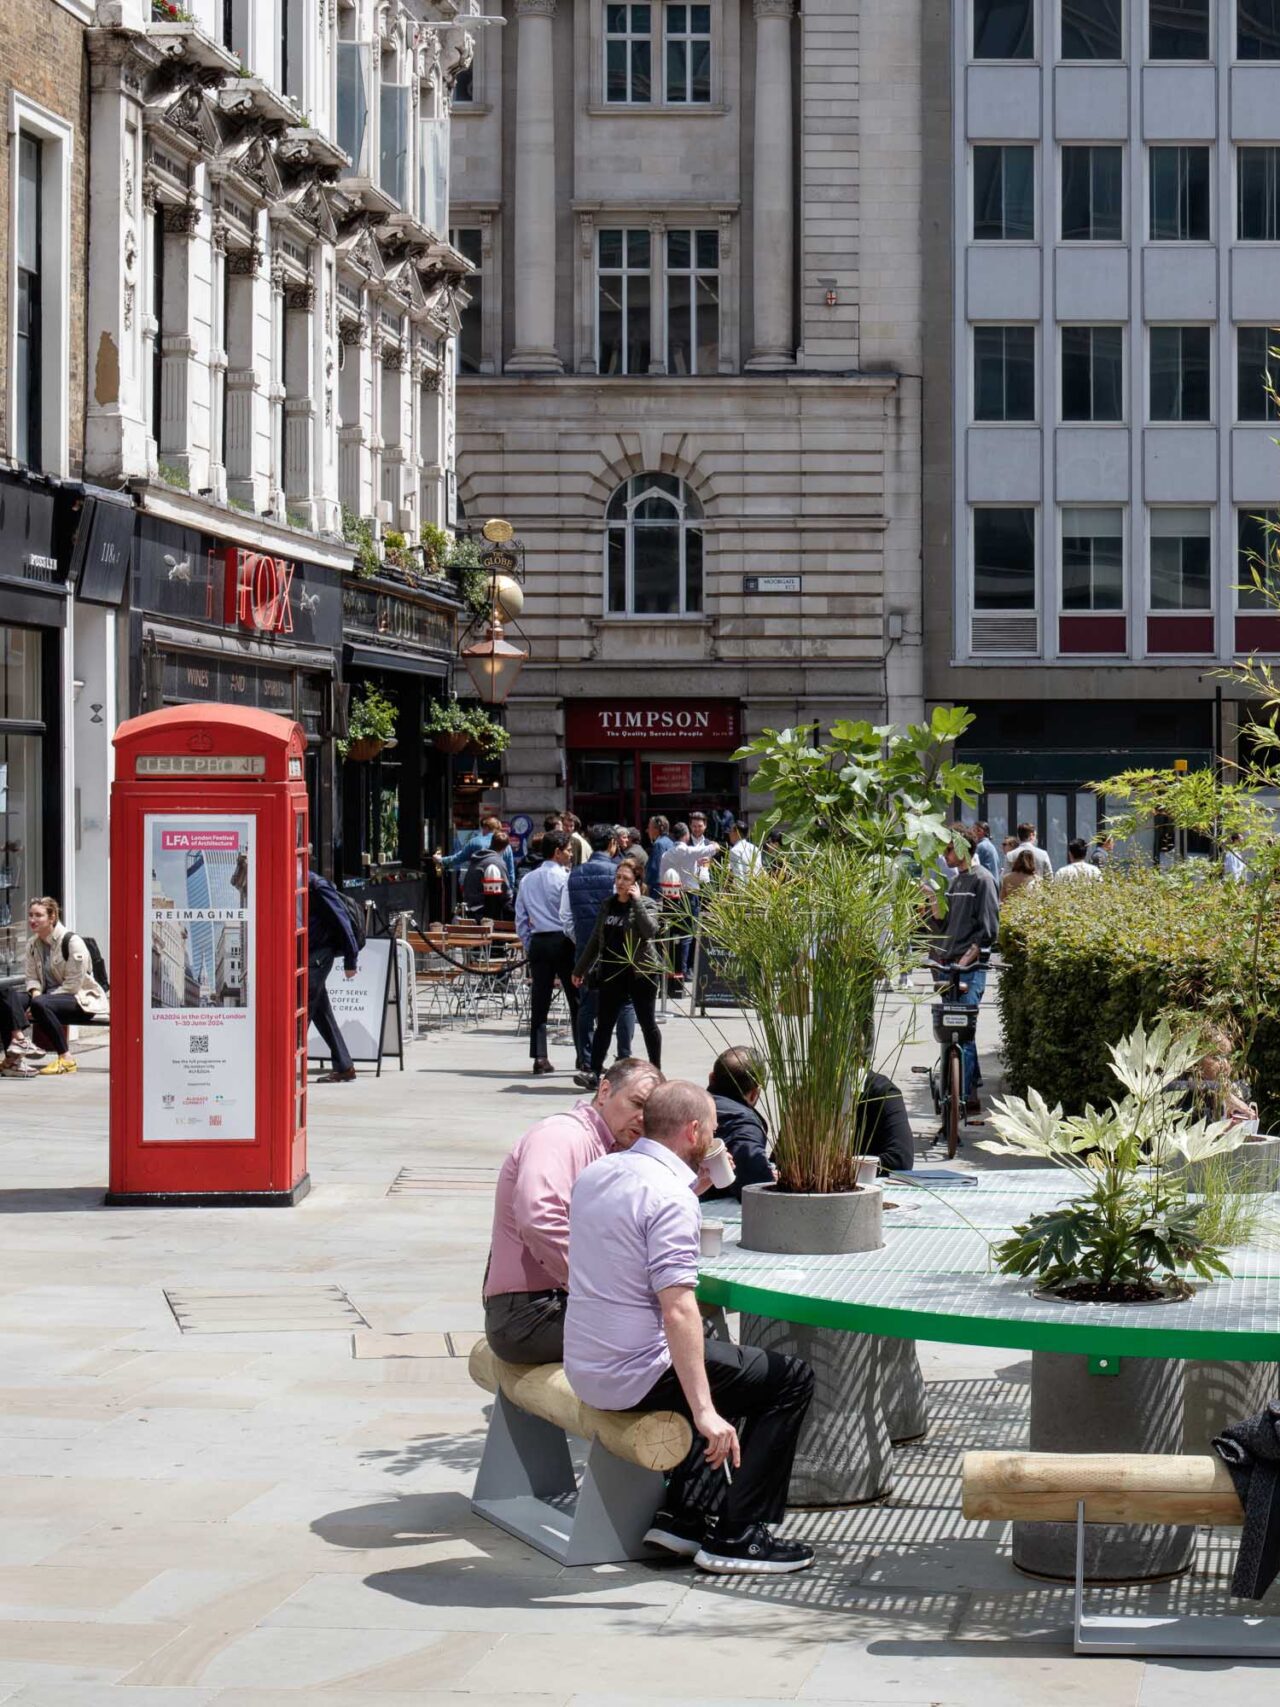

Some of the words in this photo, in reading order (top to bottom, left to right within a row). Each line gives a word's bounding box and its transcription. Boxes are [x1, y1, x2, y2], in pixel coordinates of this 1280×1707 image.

[483, 556, 513, 568] GLOBE
[224, 546, 295, 635] FOX
[187, 667, 209, 688] WINES
[231, 674, 246, 693] AND
[598, 711, 710, 728] TIMPSON
[166, 835, 189, 846] LFA
[155, 911, 244, 919] REIMAGINE
